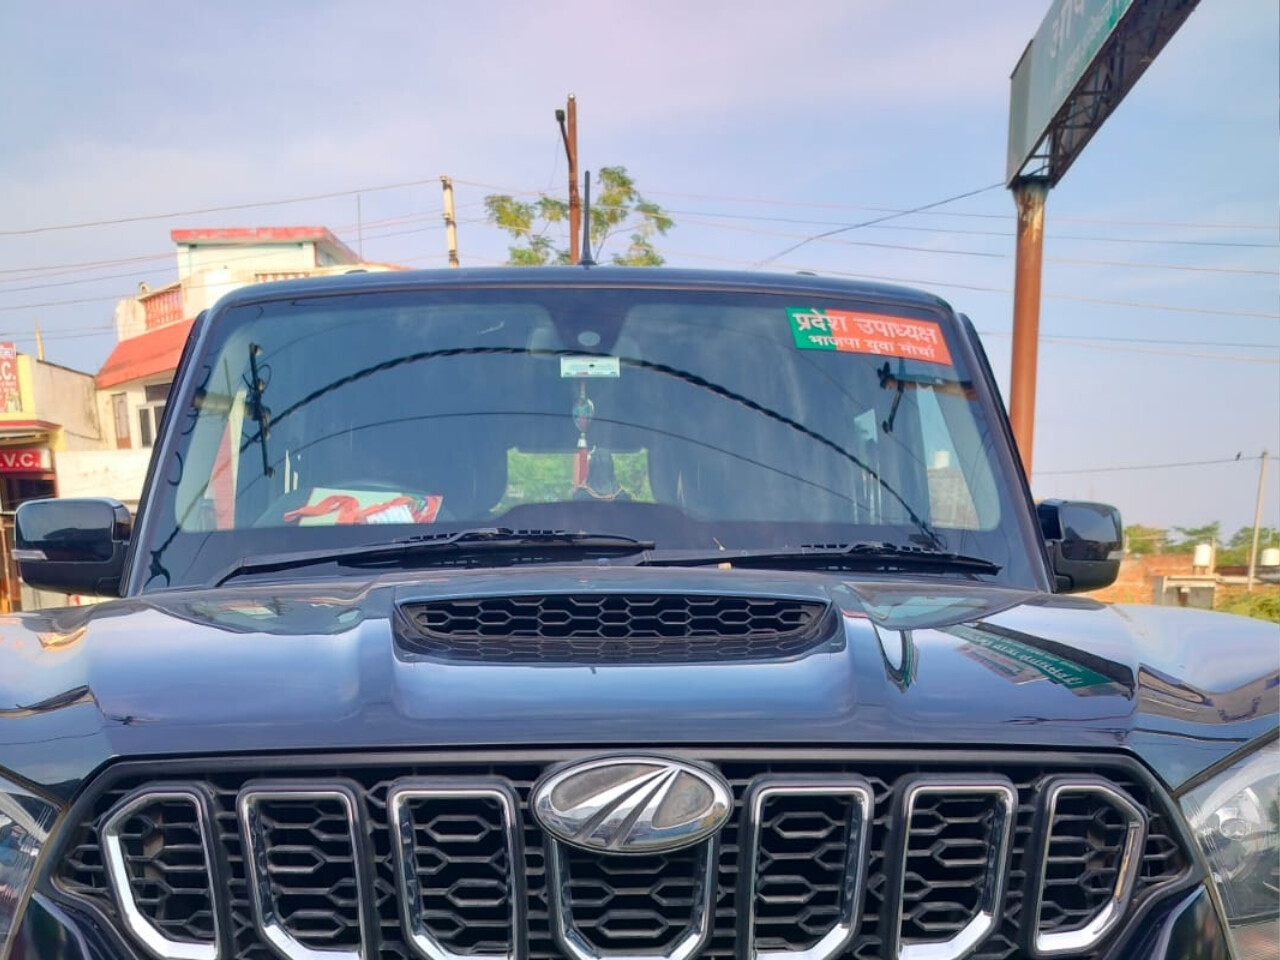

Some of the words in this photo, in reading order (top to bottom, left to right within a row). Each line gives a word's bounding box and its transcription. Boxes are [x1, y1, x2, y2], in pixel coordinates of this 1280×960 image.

[792, 308, 847, 332] प्रदेश
[853, 317, 938, 344] उपाध्यक्ष
[808, 335, 861, 349] भाजपा
[864, 339, 894, 354] युवा
